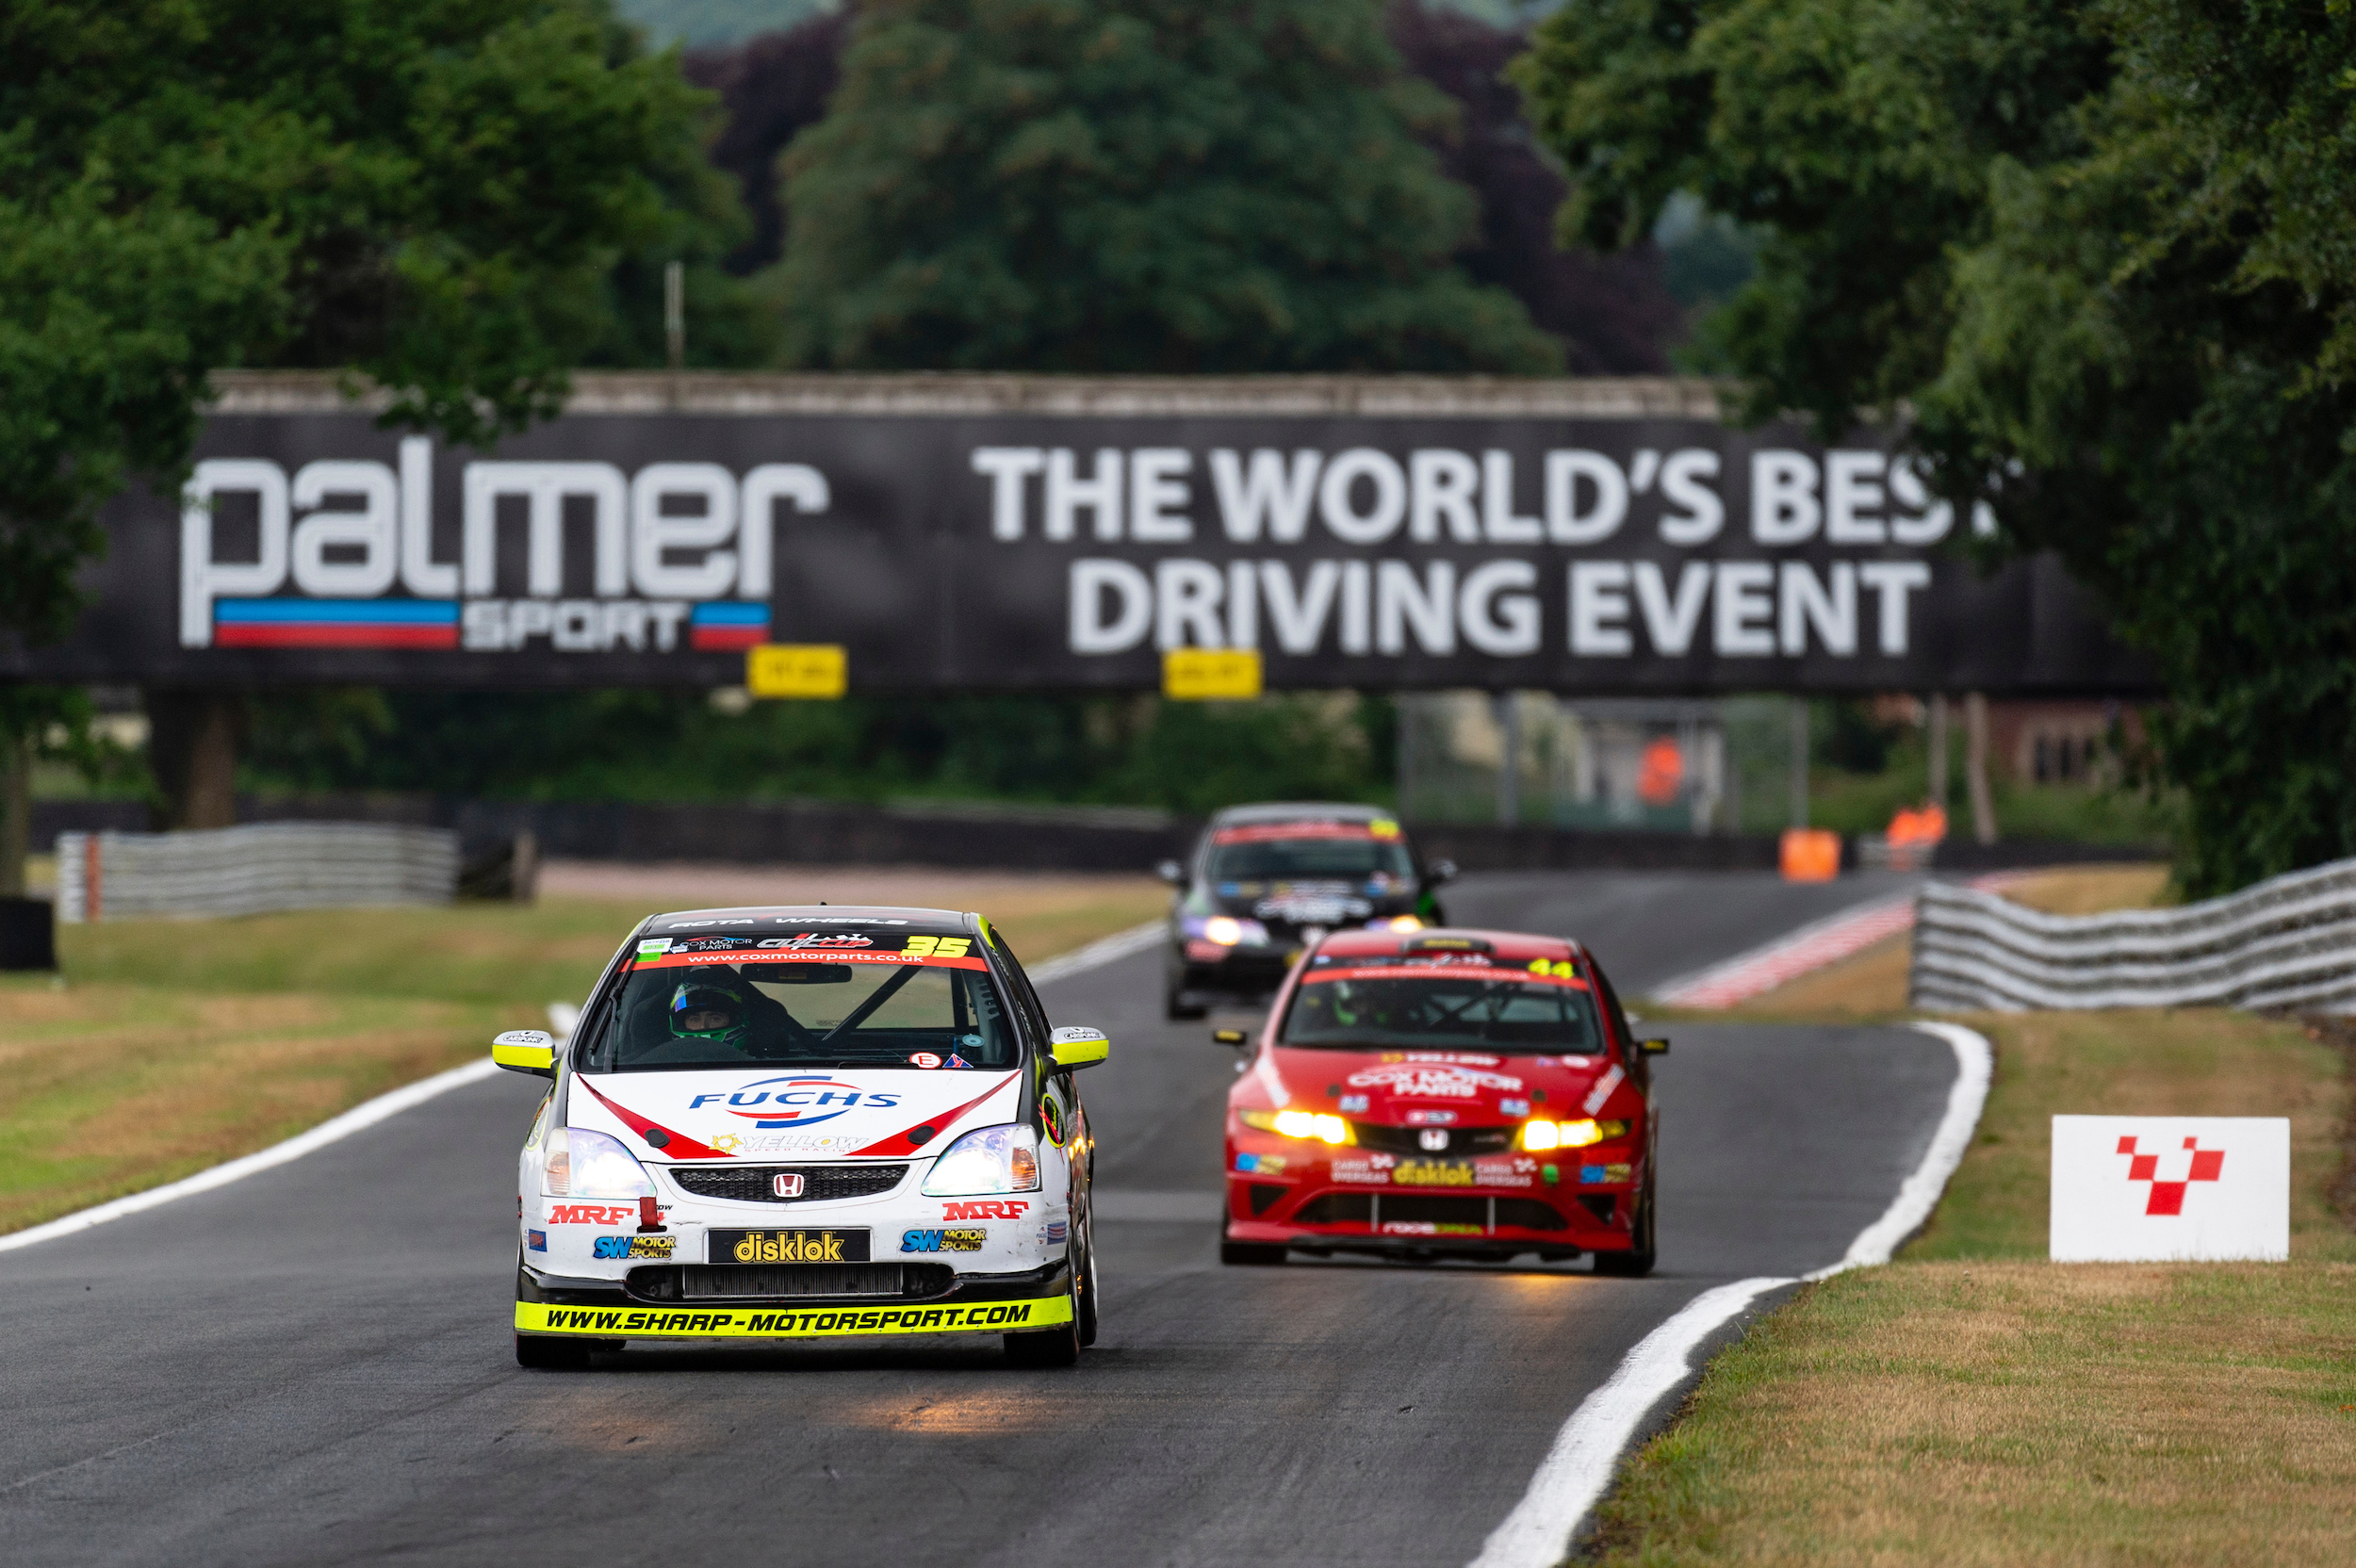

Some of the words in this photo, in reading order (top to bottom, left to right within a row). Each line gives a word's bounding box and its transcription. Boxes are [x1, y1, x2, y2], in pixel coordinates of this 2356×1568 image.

[972, 447, 1194, 542] THE
[1209, 446, 1725, 544] WORLD'S
[180, 435, 830, 649] palmer
[1068, 562, 1543, 657] DRIVING
[1569, 562, 1931, 657] EVENT
[462, 600, 689, 652] SPORT
[668, 919, 754, 929] ROTA
[708, 938, 753, 946] MOTOR
[900, 935, 973, 958] 35
[688, 952, 924, 964] www.coxmotorparts.co.uk
[1529, 958, 1574, 979] 44
[918, 1055, 934, 1066] E
[1348, 1070, 1413, 1086] COX
[1417, 1069, 1523, 1092] MOTOR
[1394, 1083, 1478, 1098] PARTS
[689, 1091, 902, 1110] FUCHS
[743, 1135, 870, 1150] YELLOW
[1393, 1158, 1475, 1185] disklok
[548, 1204, 634, 1226] MRF
[942, 1200, 1030, 1222] MRF
[593, 1235, 635, 1260] SW
[631, 1235, 677, 1248] MOTOR
[733, 1231, 845, 1264] disklok
[900, 1229, 945, 1253] SW
[942, 1228, 988, 1241] MOTOR
[939, 1239, 982, 1252] SPORTS
[628, 1247, 672, 1259] SPORTS
[546, 1304, 1032, 1331] WWW.SHARP-MOTORSPORT.COM
